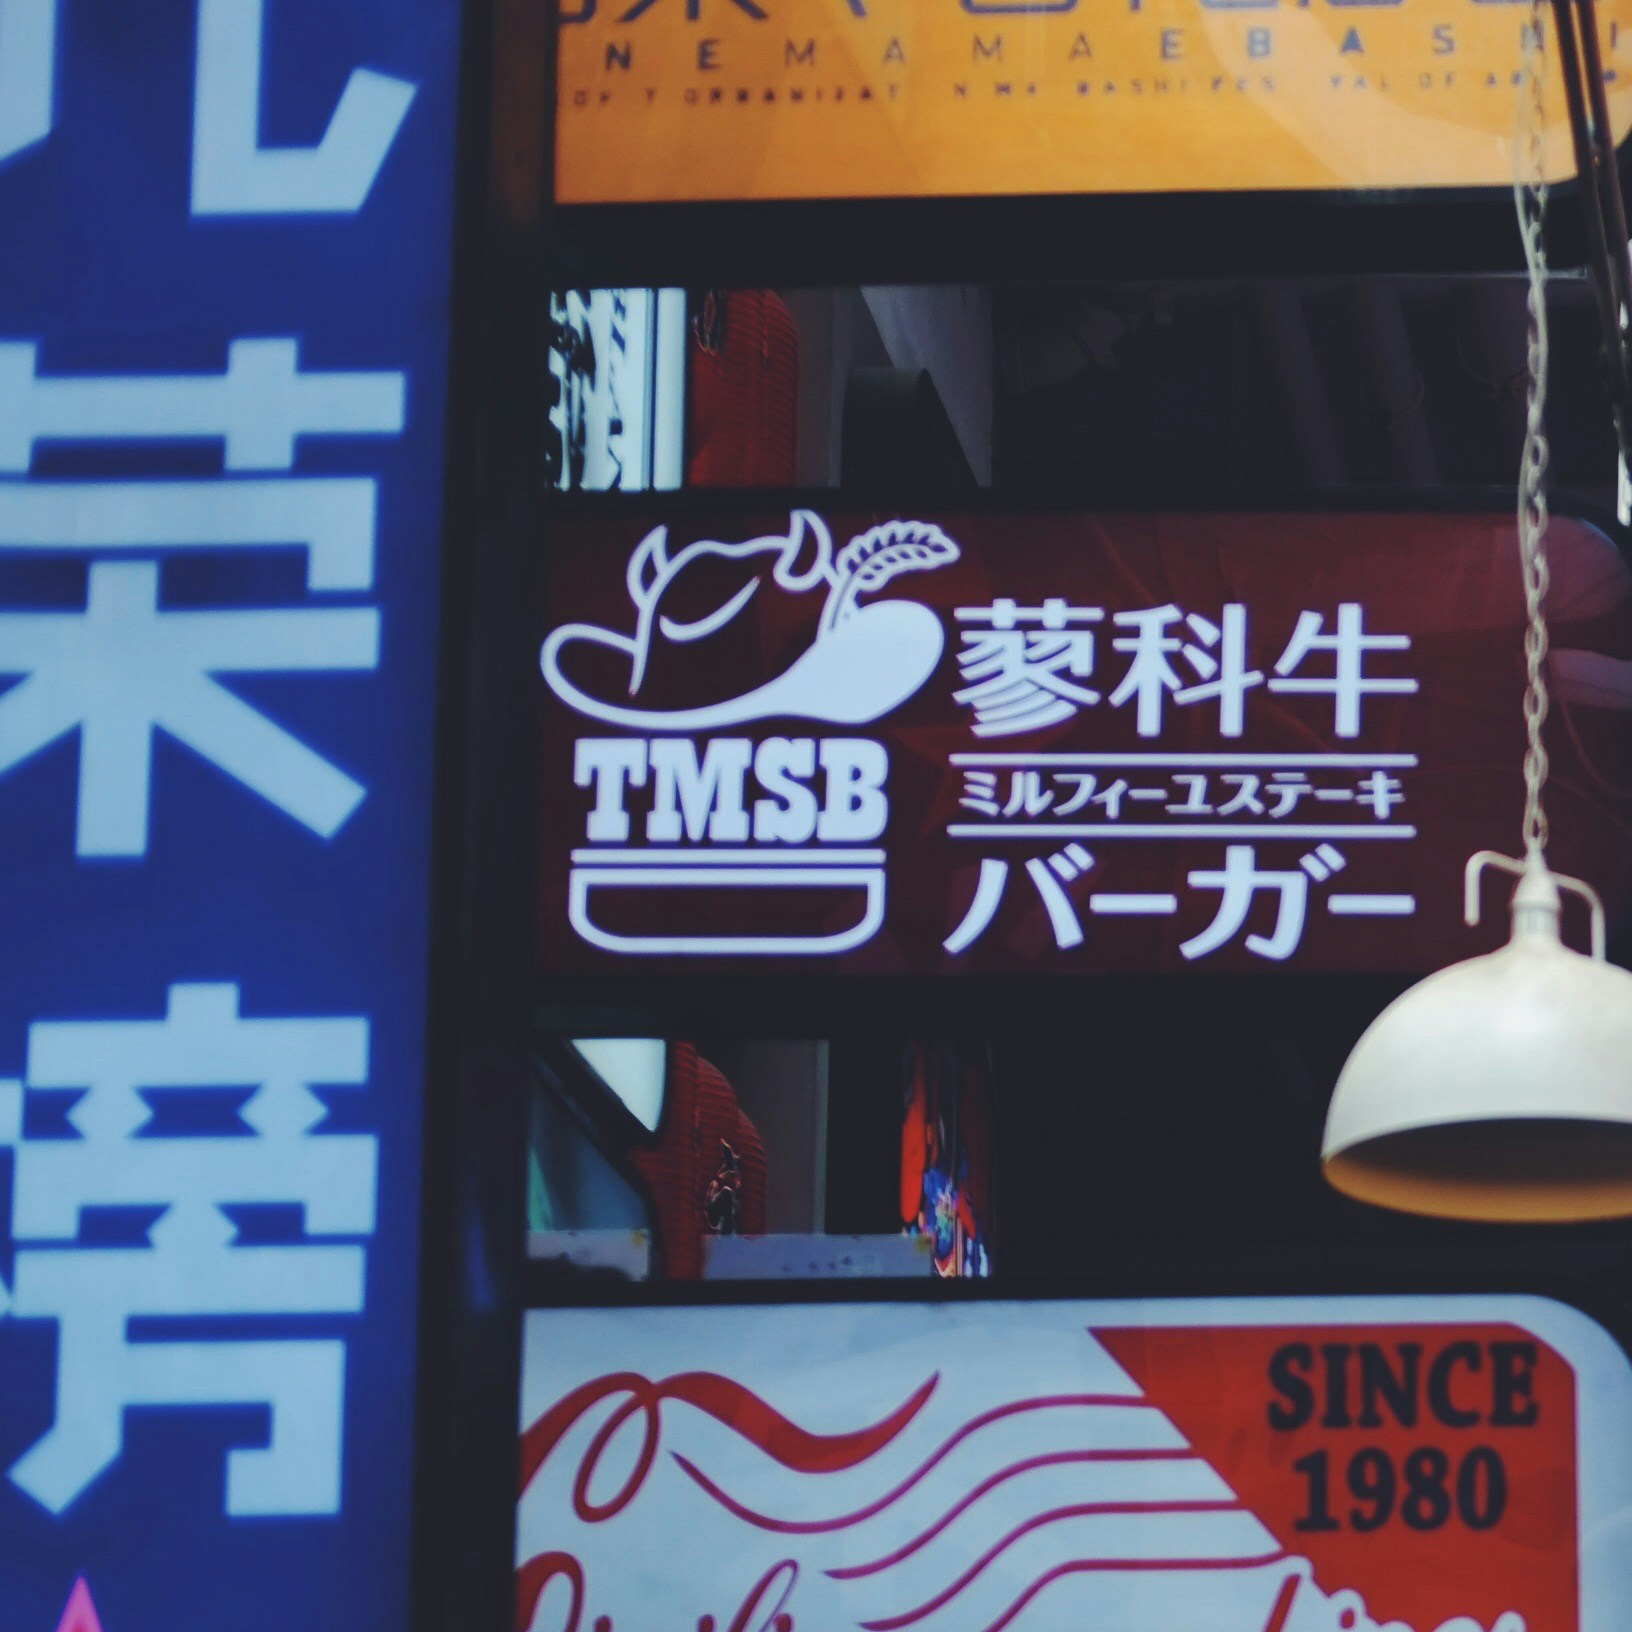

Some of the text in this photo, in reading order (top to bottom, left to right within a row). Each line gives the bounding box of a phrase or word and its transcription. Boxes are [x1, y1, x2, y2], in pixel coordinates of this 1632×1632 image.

[950, 597, 1420, 739] 蓼科牛
[574, 737, 890, 843] TMSB
[957, 769, 1407, 820] ミルフィーユステーキ
[940, 842, 1417, 962] バーガー
[1265, 1340, 1540, 1432] SINCE
[1292, 1445, 1509, 1533] 1980
